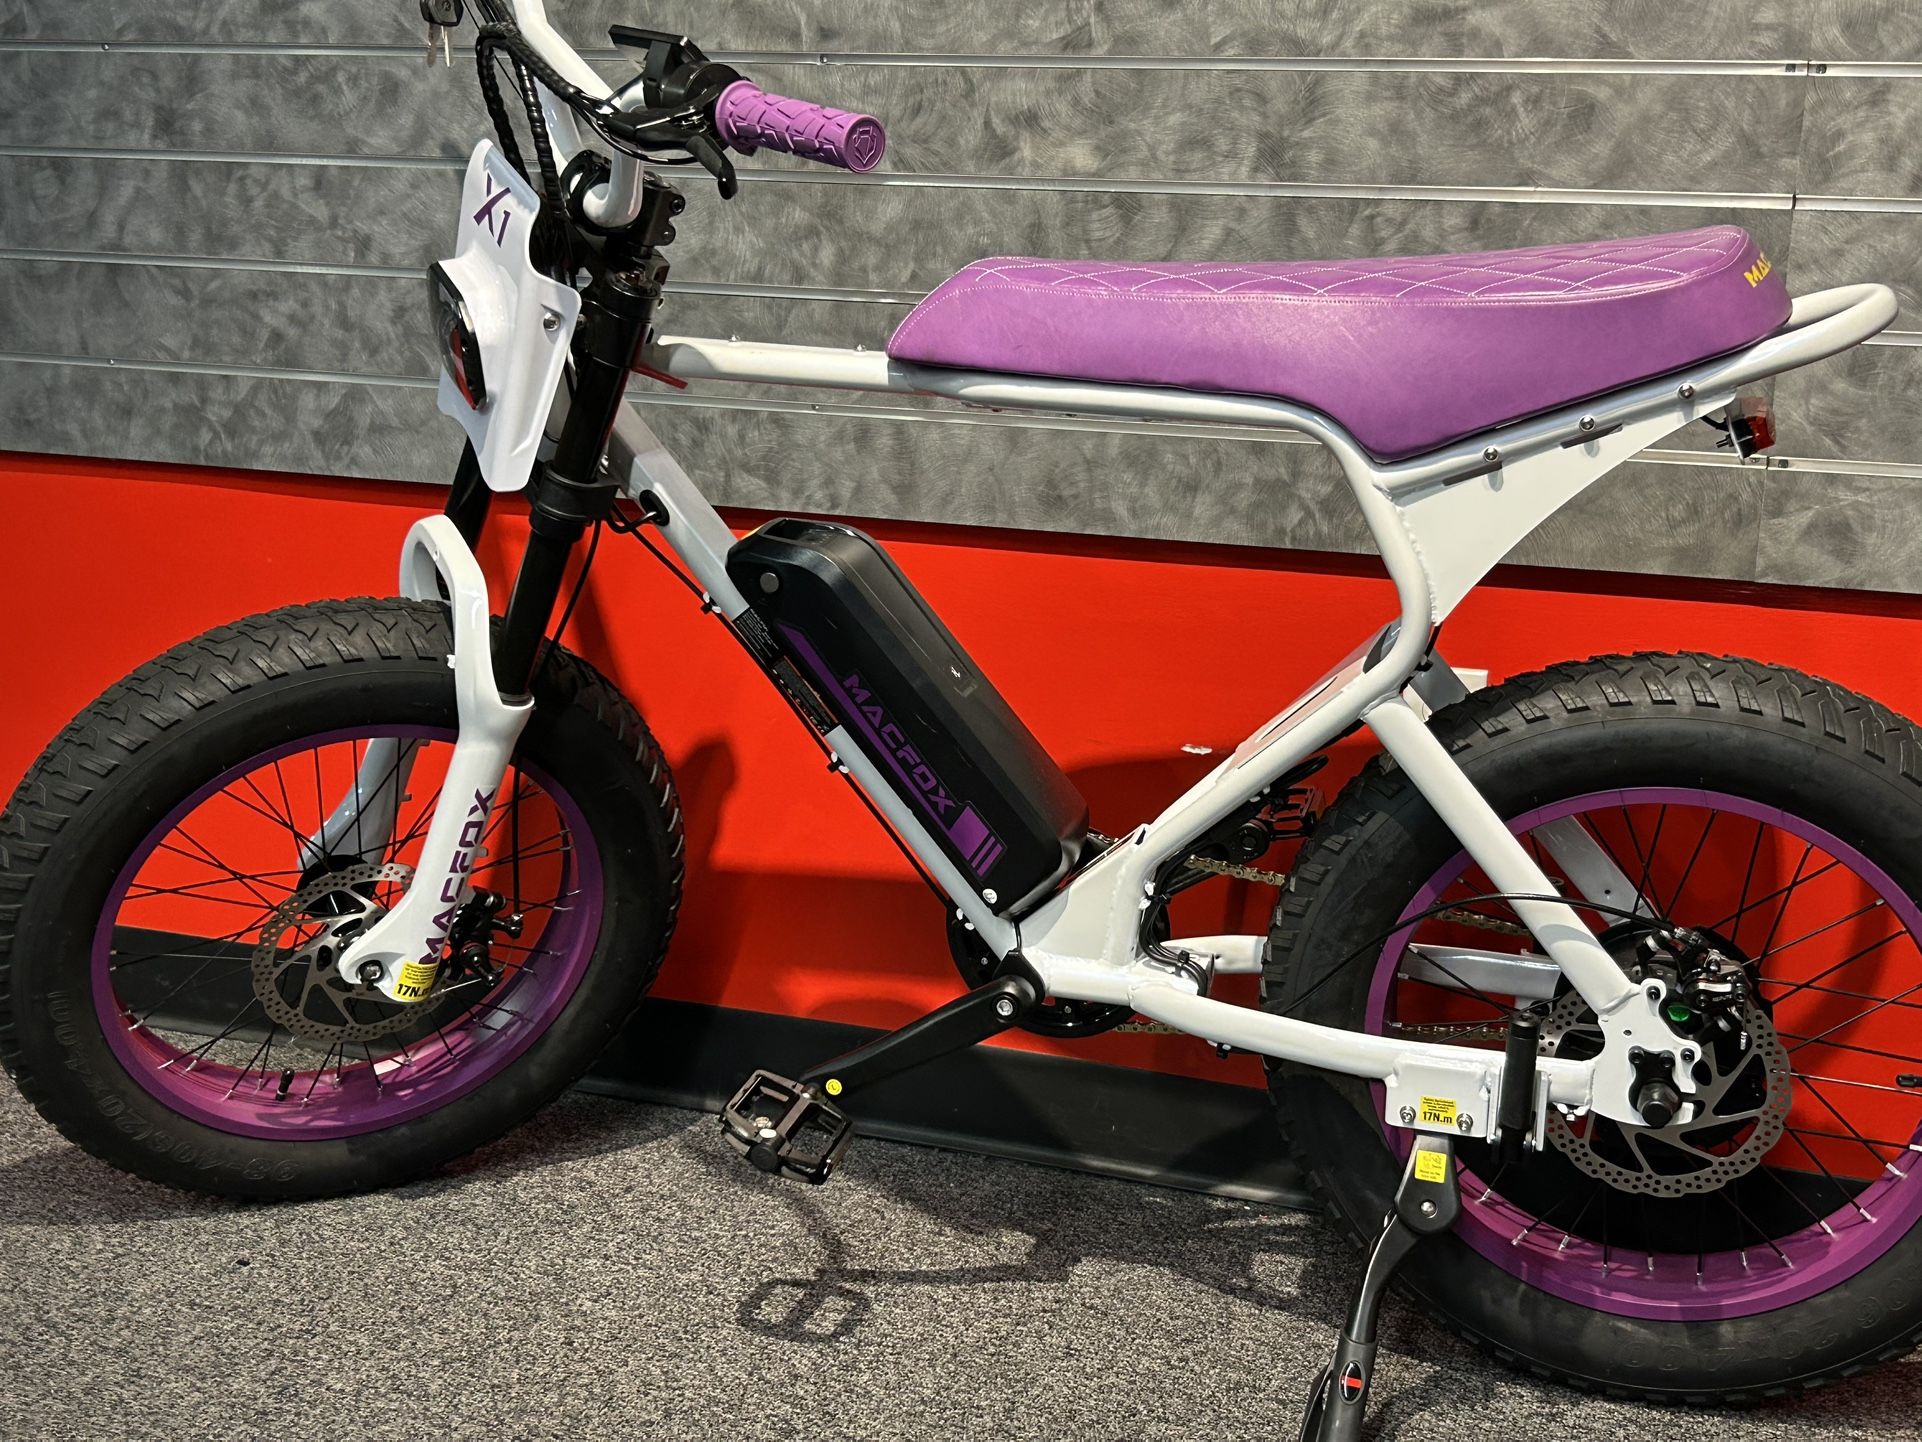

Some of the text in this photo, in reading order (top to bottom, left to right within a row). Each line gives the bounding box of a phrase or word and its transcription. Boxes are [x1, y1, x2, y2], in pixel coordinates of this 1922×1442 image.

[473, 172, 511, 248] X1
[843, 673, 956, 816] MACFOX
[418, 788, 496, 965] MACFOX
[1422, 1111, 1453, 1124] 17N.m
